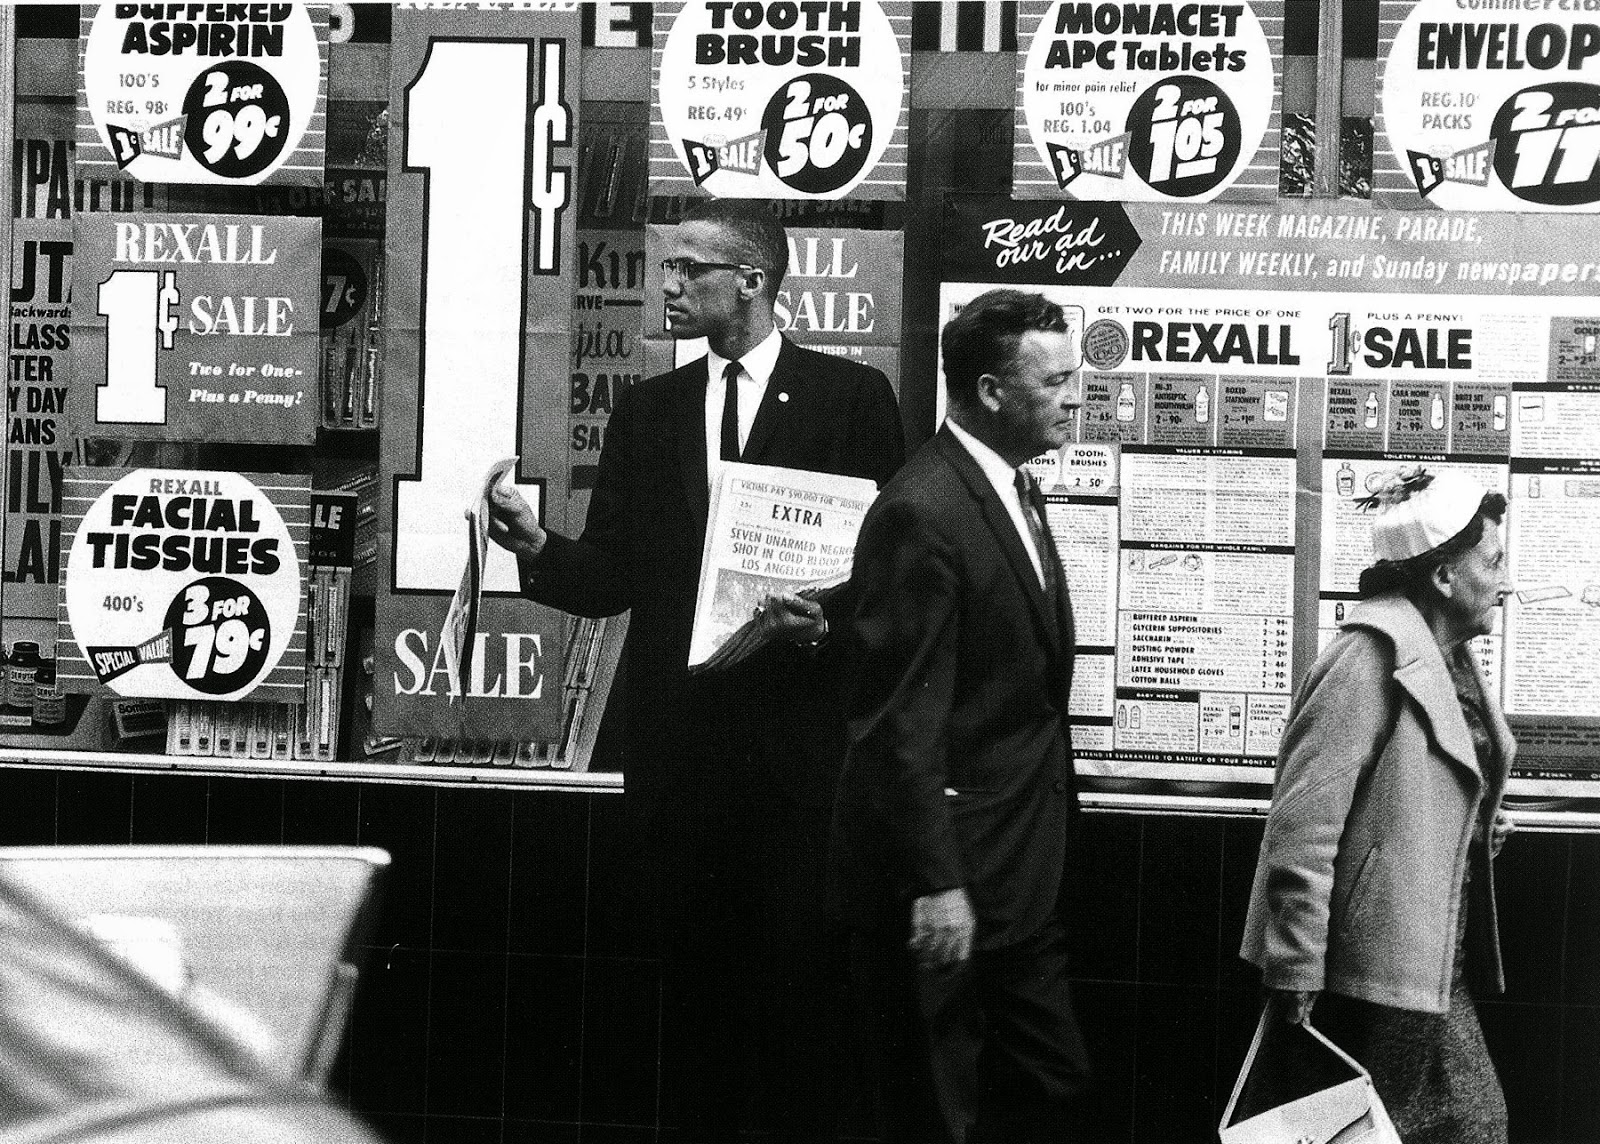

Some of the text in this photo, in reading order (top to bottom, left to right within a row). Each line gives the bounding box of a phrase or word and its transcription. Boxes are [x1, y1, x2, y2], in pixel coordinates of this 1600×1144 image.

[706, 2, 860, 31] TOOTH
[1055, 3, 1244, 37] MONACET
[121, 22, 284, 57] ASPIRIN
[695, 34, 861, 67] BRUSH
[1417, 23, 1600, 70] ENVELOP
[1045, 40, 1247, 72] APC Tablets
[203, 71, 264, 107] 2 FOR
[688, 76, 745, 91] 5 Styles
[1036, 81, 1137, 94] for minor pain relief
[107, 100, 139, 114] REG.
[783, 80, 849, 120] 2 FOR
[1152, 84, 1218, 121] 2 FOR
[1510, 92, 1554, 131] 2
[1043, 119, 1111, 133] REG. 1.04
[1422, 114, 1472, 130] PACKS
[142, 125, 181, 154] SALE
[719, 139, 760, 169] SALE
[1083, 142, 1124, 173] SALE
[1445, 150, 1489, 180] SALE
[982, 206, 1073, 249] Read
[1161, 212, 1482, 244] THIS WEEK MAGAZINE, PARADE,
[111, 222, 278, 264] REXALL
[996, 218, 1105, 267] our ad
[1160, 251, 1235, 275] FAMILY
[1239, 251, 1318, 279] WEEKLY,
[1327, 256, 1365, 278] and
[1373, 255, 1450, 284] Sunday
[189, 296, 294, 337] SALE
[773, 292, 875, 333] SALE
[1098, 306, 1119, 314] GET
[1125, 306, 1153, 314] TWO
[1158, 307, 1183, 315] FOR
[1216, 308, 1250, 317] PRICE
[1256, 309, 1272, 317] OF
[1277, 310, 1301, 318] ONE
[1368, 312, 1399, 320] PLUS
[9, 324, 70, 350] LASS
[1132, 321, 1300, 365] REXALL
[1364, 326, 1472, 369] SALE
[851, 346, 862, 355] IN
[189, 362, 222, 377] Two
[229, 363, 255, 377] for
[27, 387, 68, 413] DAY
[188, 390, 303, 408] Plus a Penny!
[1155, 393, 1187, 401] ANTISEPTIC
[1155, 402, 1193, 410] MOUTHWASH
[1225, 396, 1260, 404] STATIONERY
[1329, 407, 1356, 415] ALCOHOL
[1071, 459, 1107, 467] BRUSHES
[150, 478, 223, 496] REXALL
[771, 484, 786, 497] PAY
[111, 494, 260, 532] FACIAL
[772, 504, 822, 527] EXTRA
[730, 527, 816, 552] SEVEN UNARMED
[87, 532, 281, 575] TISSUES
[733, 542, 759, 556] SHOT
[762, 548, 774, 559] IN
[779, 550, 803, 565] COLD
[741, 558, 806, 577] LOS ANGELES
[182, 585, 250, 625] 3 FOR
[1133, 613, 1167, 621] BUFFERED
[1133, 624, 1223, 634] GLYCERIN SUPPOSITORIES
[1133, 634, 1171, 642] SACCHARIN
[94, 636, 170, 676] SPECIAL VALUE
[1132, 645, 1195, 654] DUSTING POWDER
[1132, 655, 1185, 664] ADHESIVE TAPE
[393, 628, 543, 699] SALE
[1155, 667, 1196, 675] HOUSEHOLD
[1198, 668, 1224, 676] GLOVES
[1131, 676, 1180, 685] COTTON BALLS
